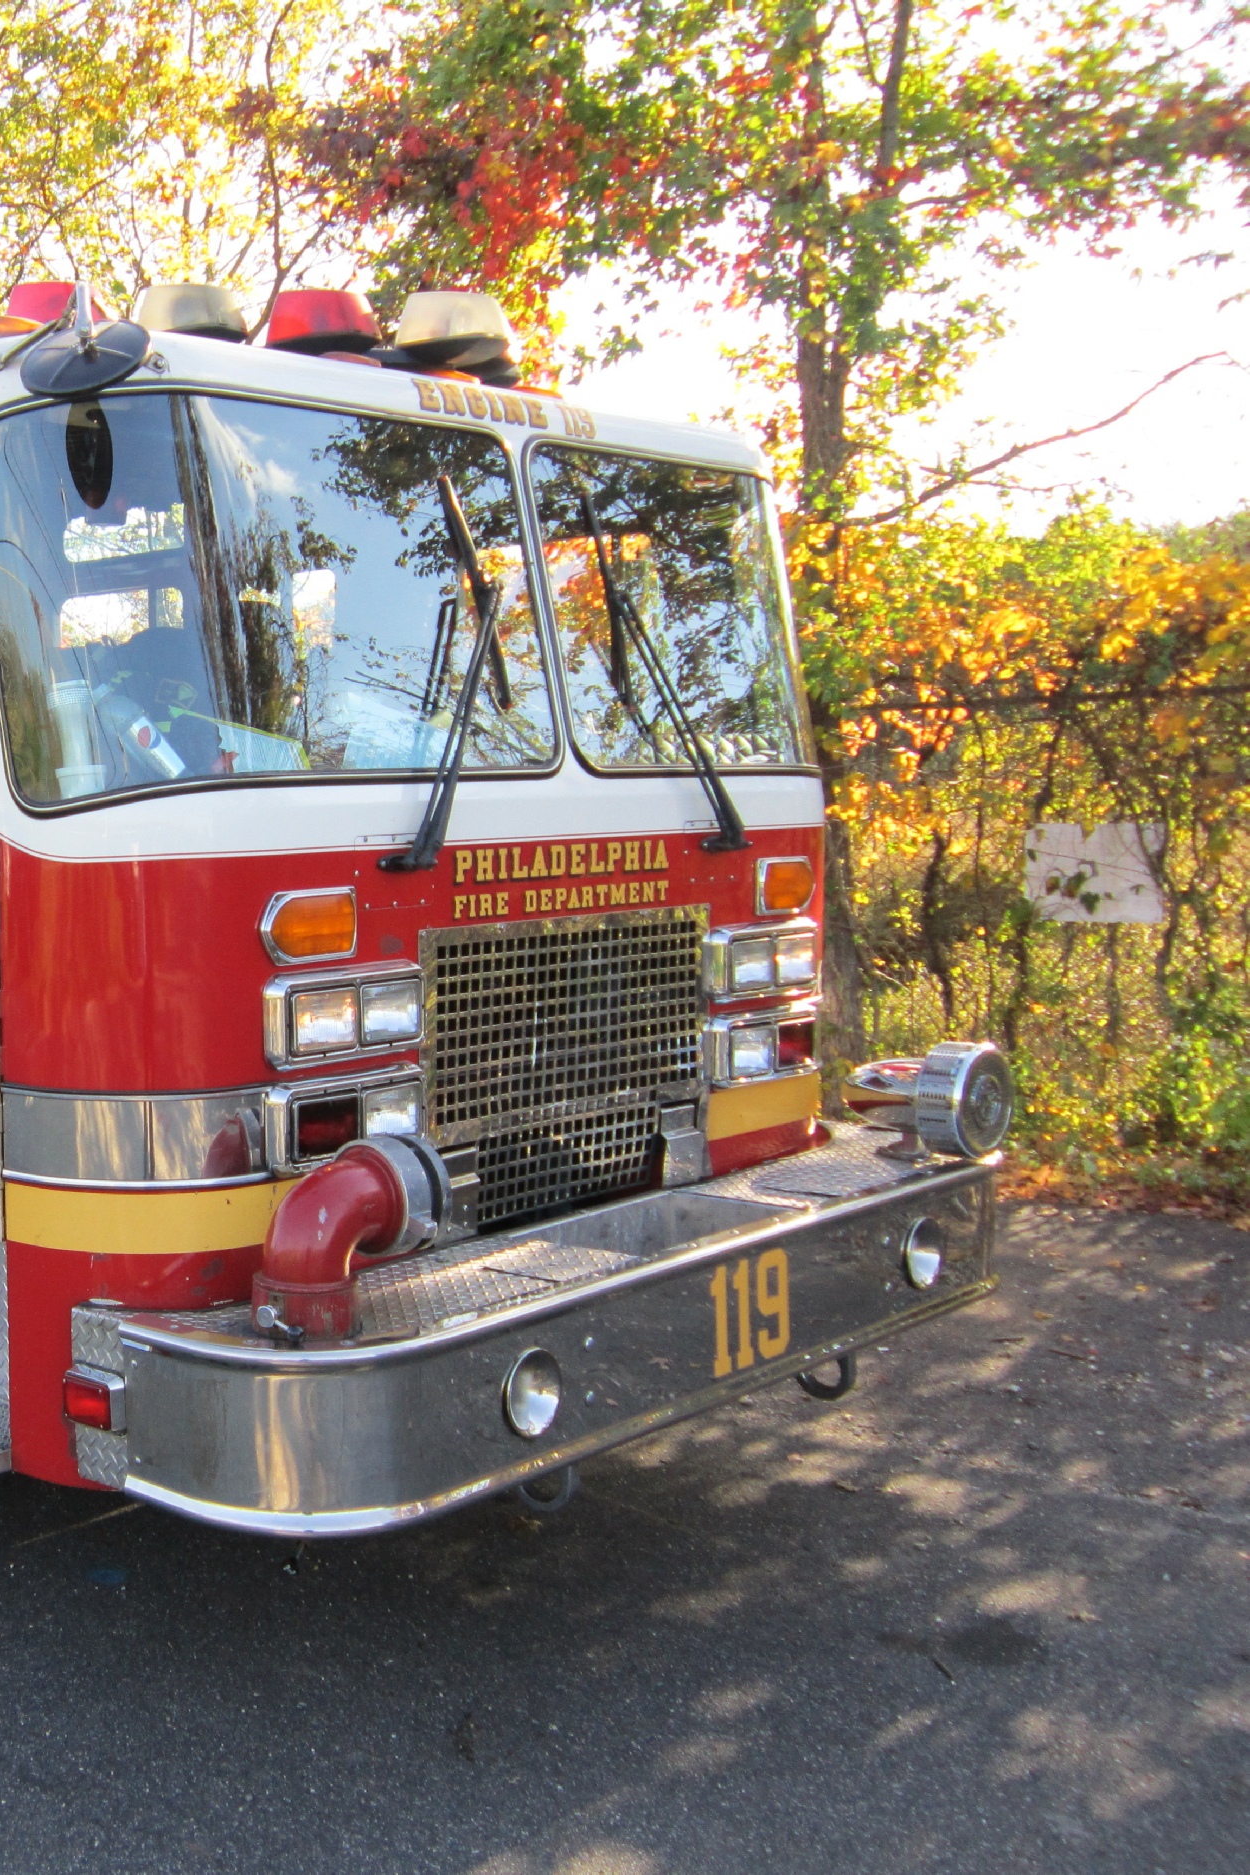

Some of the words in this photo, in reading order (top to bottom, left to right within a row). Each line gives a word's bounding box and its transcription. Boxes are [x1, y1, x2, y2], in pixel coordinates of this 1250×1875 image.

[412, 379, 549, 428] ENGINE
[555, 402, 597, 440] 119
[455, 840, 669, 883] PHILADELPHIA
[453, 892, 509, 919] FIRE
[524, 881, 669, 912] DEPARTMENT
[710, 1249, 790, 1377] 119
